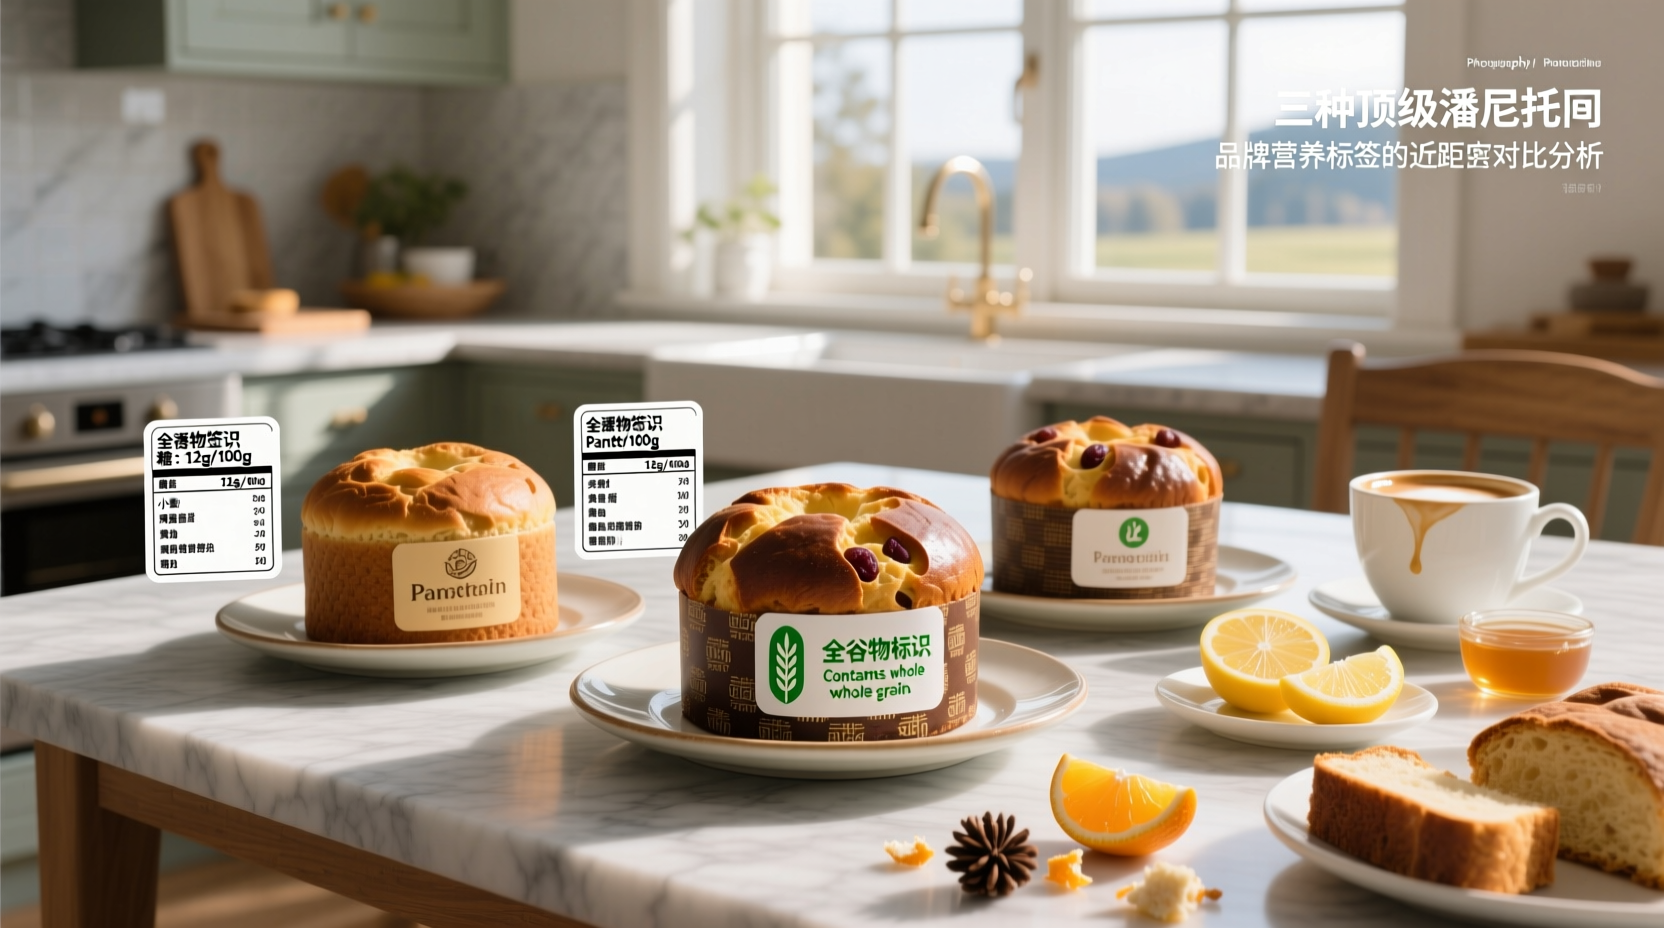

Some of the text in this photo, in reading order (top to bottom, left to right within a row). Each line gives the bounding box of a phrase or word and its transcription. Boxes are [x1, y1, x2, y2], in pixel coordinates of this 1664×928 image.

[822, 634, 931, 664] 全谷物标识
[890, 663, 925, 678] whole
[829, 682, 911, 702] whole grain
